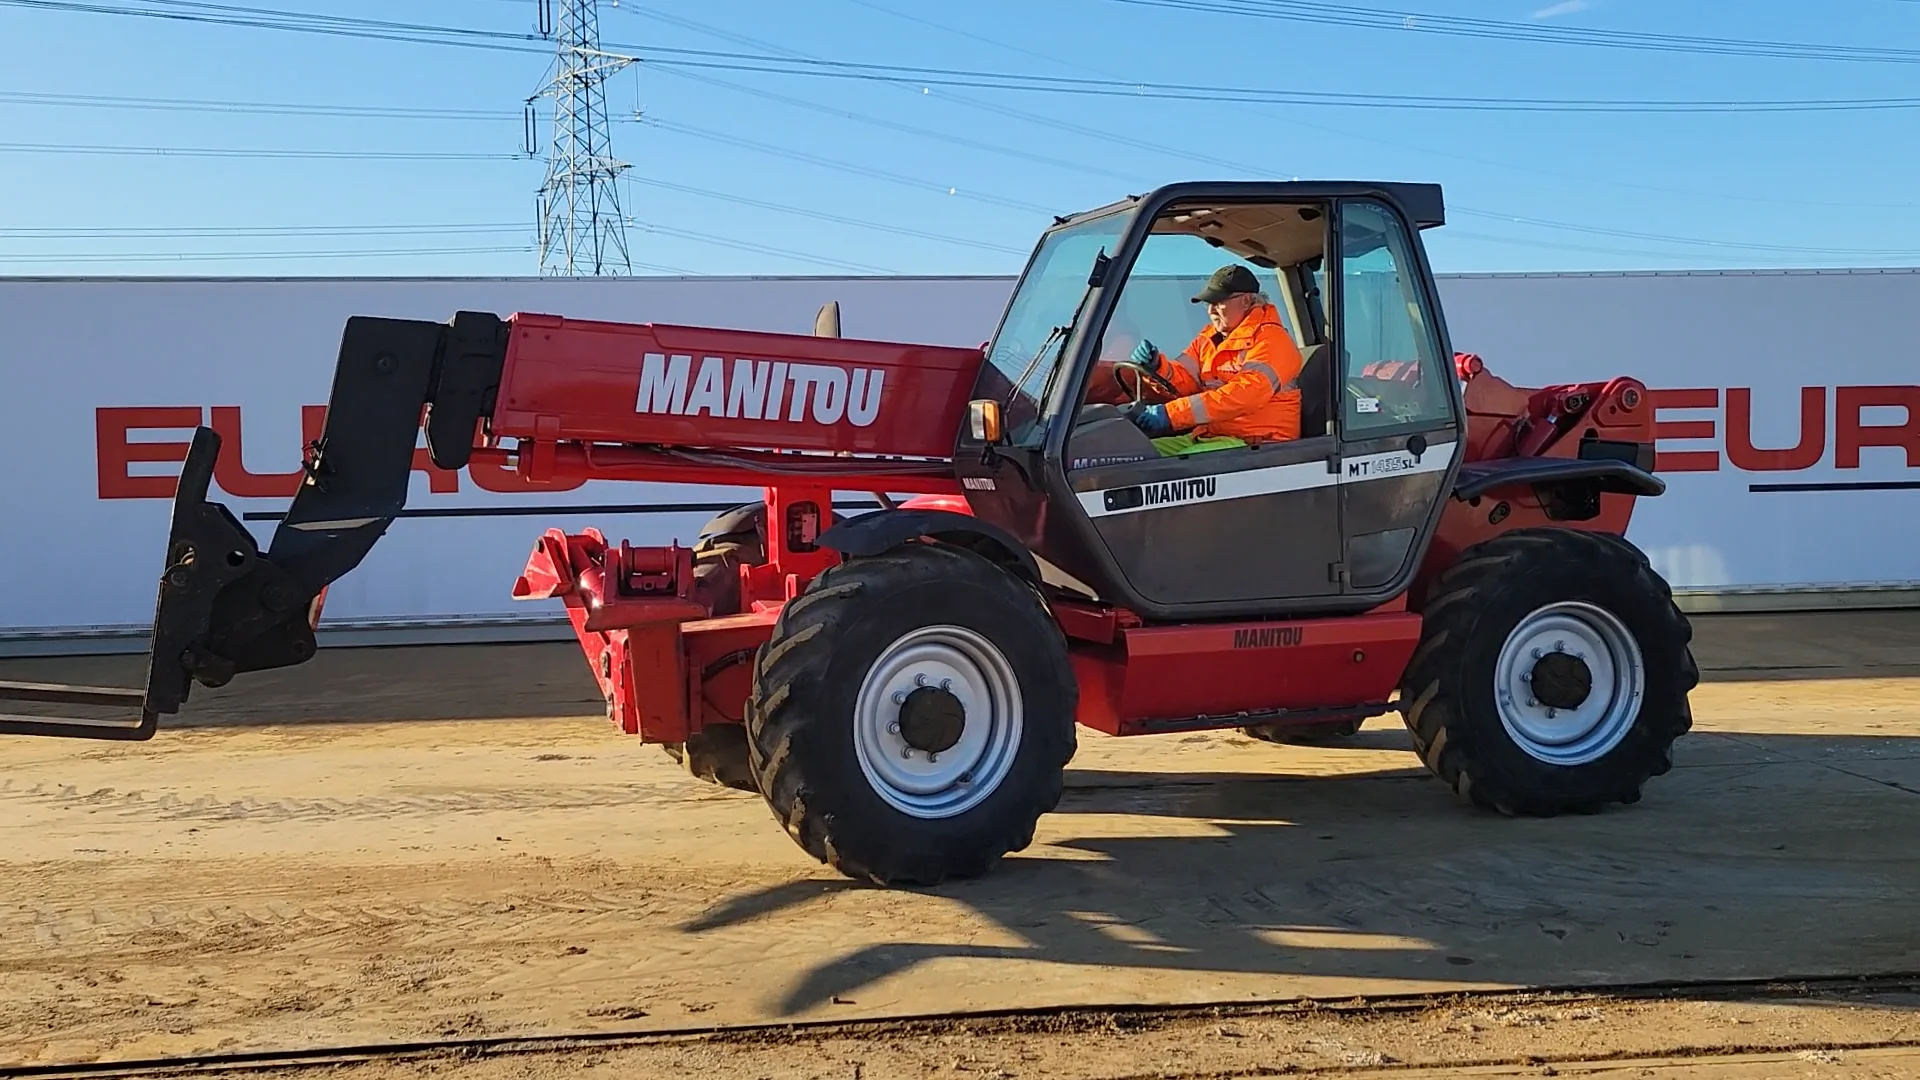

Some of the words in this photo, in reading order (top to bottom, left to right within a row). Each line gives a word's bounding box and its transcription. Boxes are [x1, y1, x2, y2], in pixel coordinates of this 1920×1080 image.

[635, 353, 885, 427] MANITOU
[962, 477, 996, 490] MANITOU
[1145, 477, 1216, 506] MANITOU
[1234, 626, 1304, 649] MANITOU
